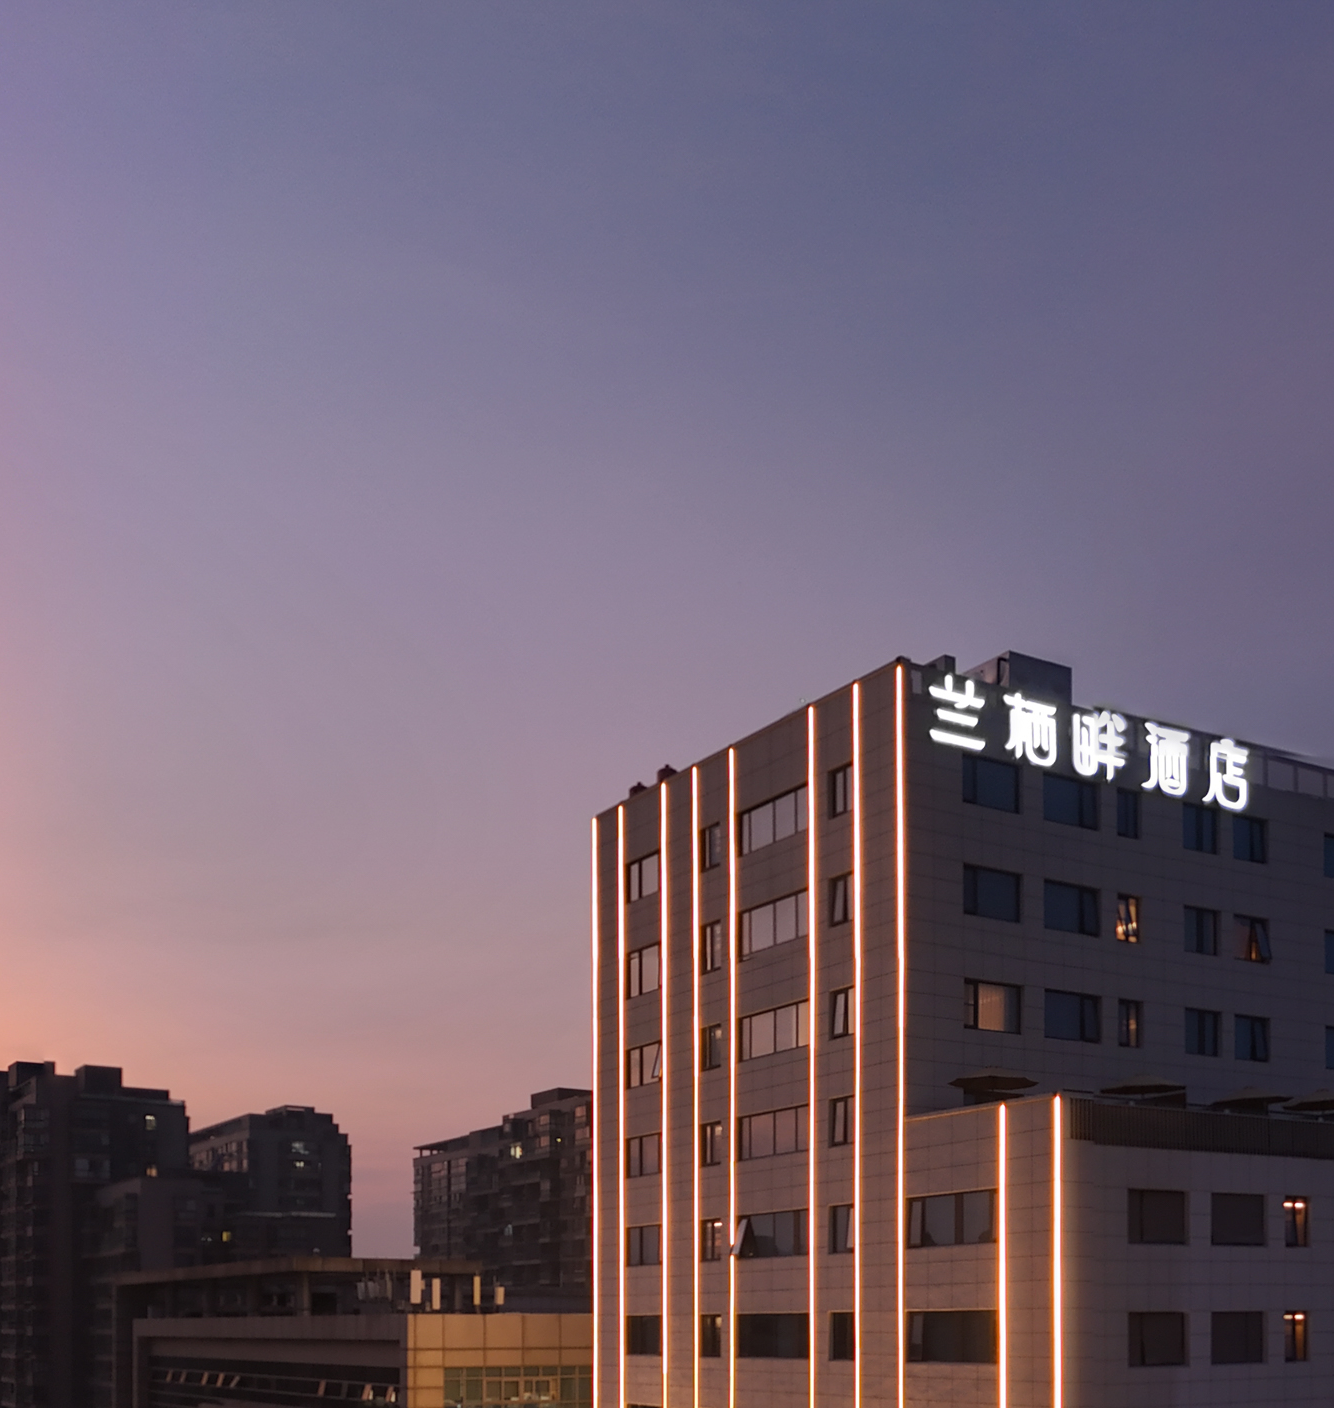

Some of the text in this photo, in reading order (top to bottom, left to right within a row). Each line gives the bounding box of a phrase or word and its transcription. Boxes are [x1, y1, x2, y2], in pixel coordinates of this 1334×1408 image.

[928, 673, 1250, 812] 兰栖畔酒店
